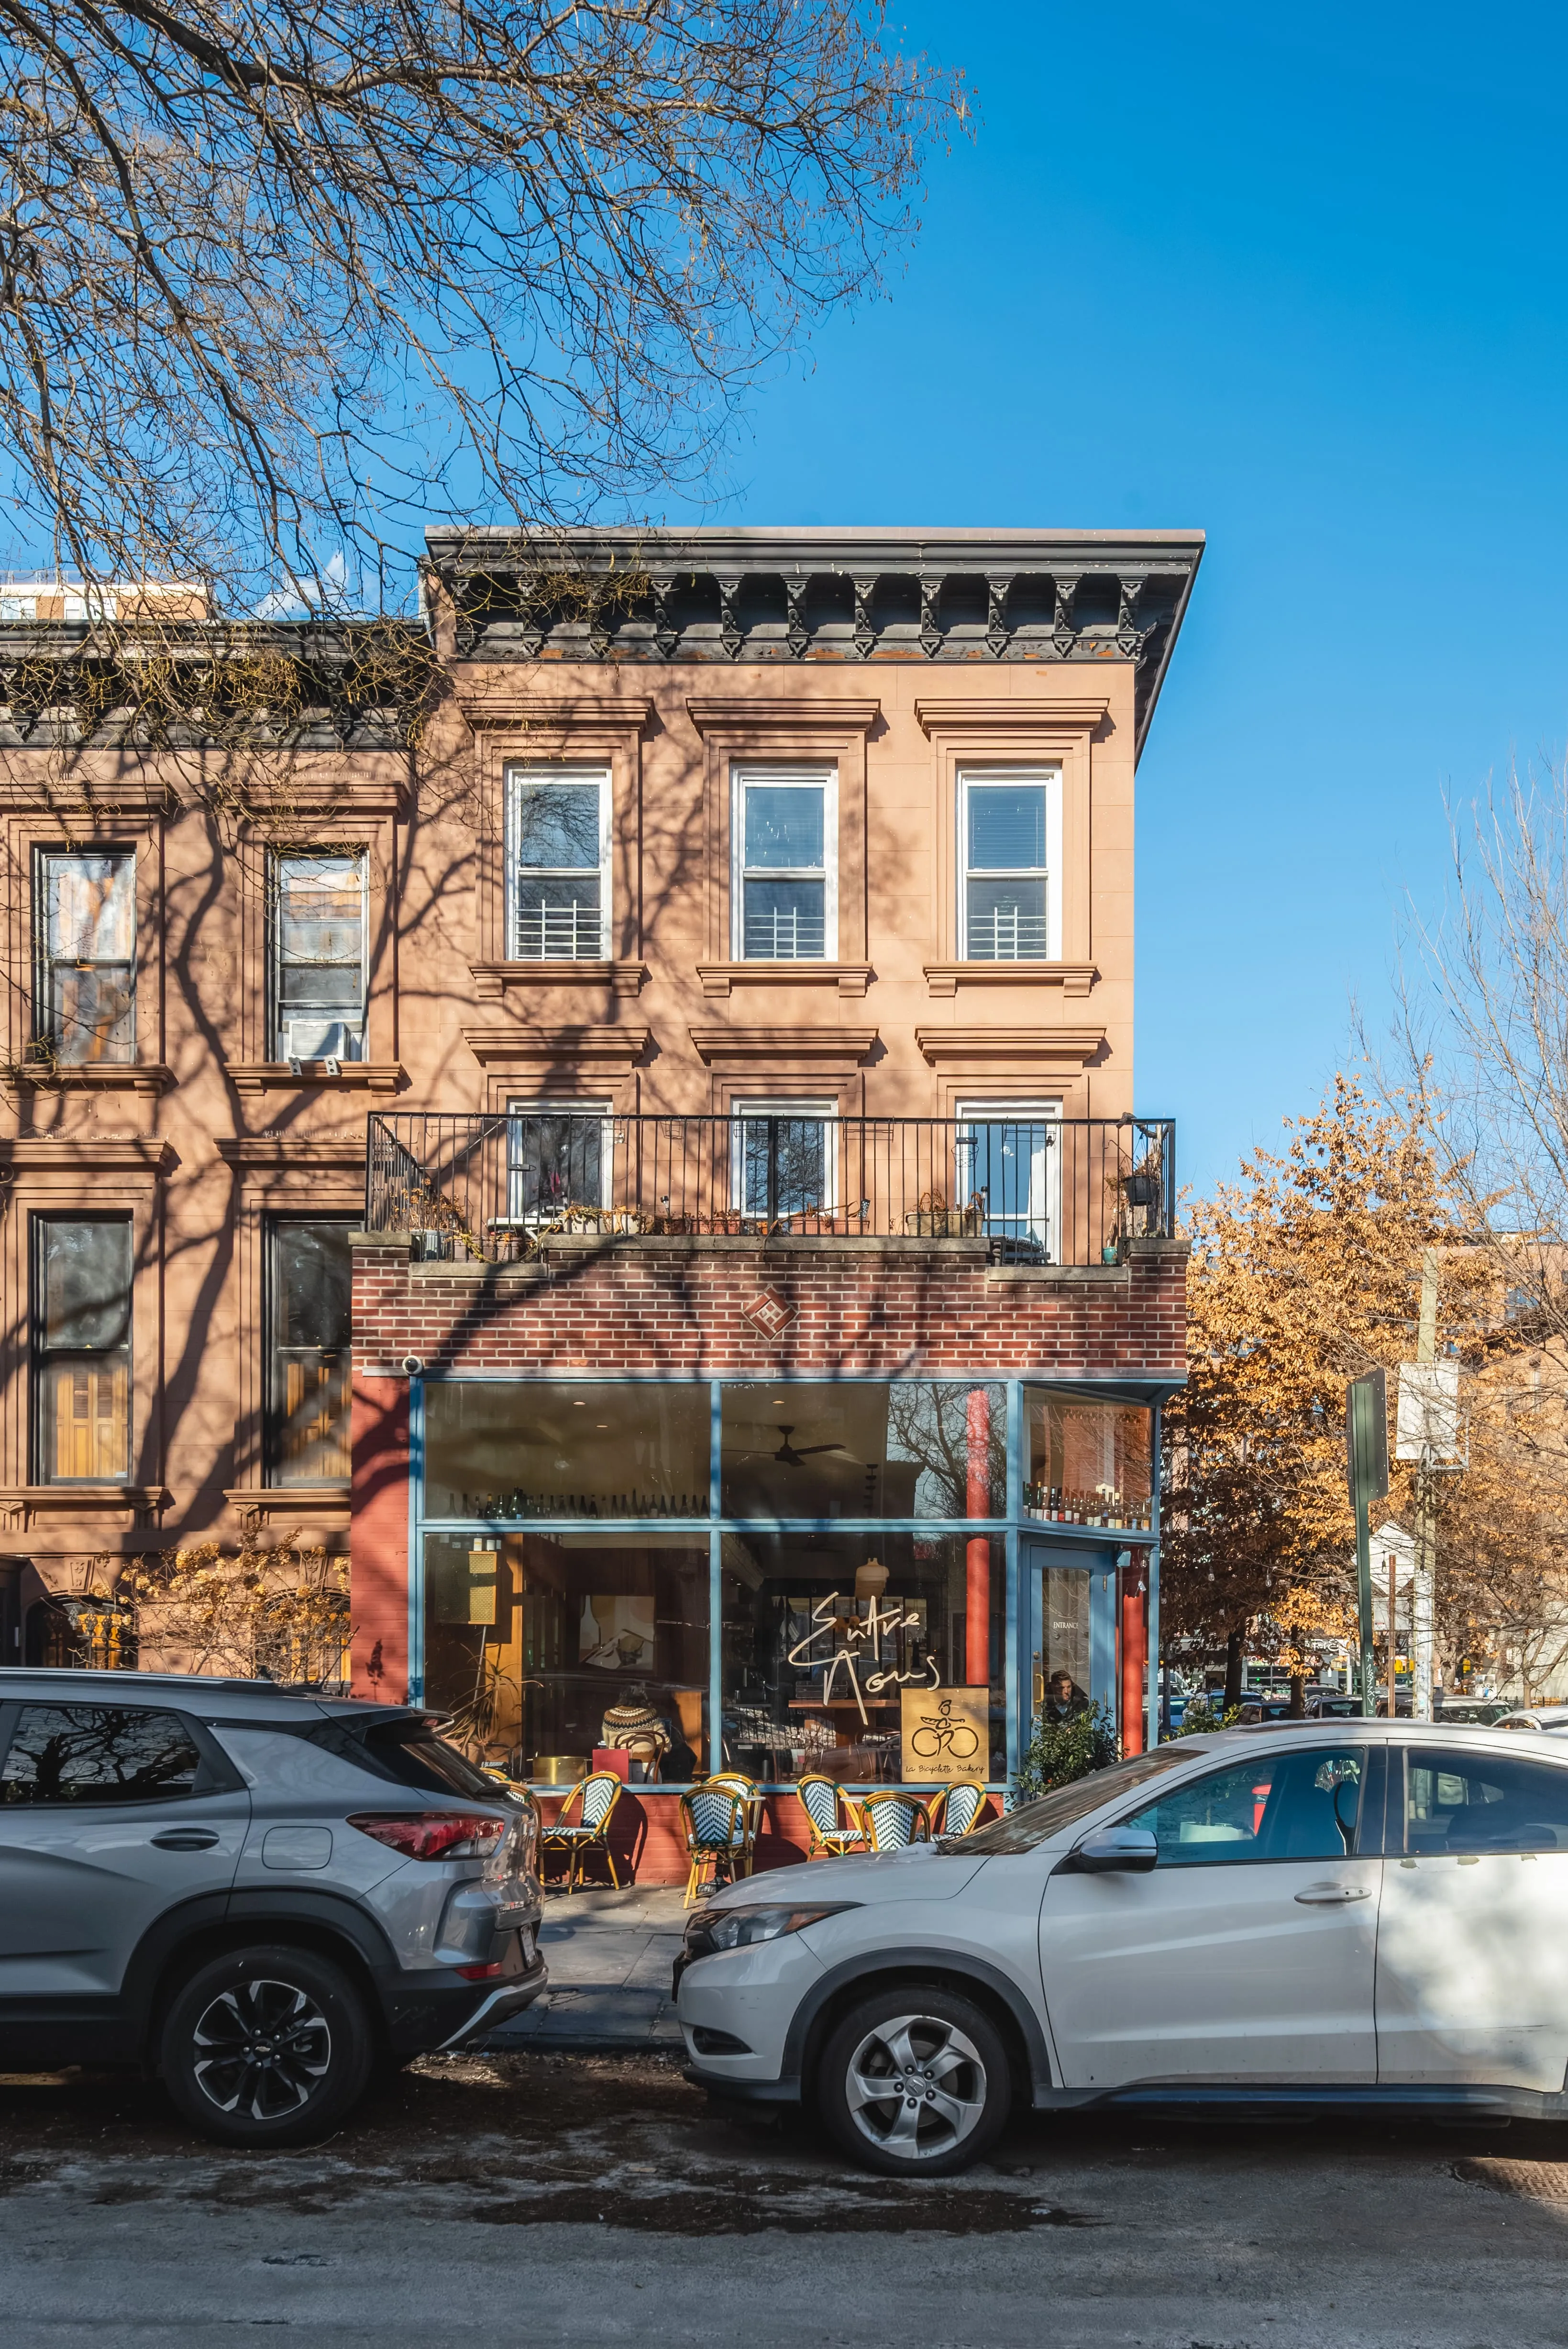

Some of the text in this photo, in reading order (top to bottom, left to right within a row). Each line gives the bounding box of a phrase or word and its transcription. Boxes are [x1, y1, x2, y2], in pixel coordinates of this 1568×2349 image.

[788, 1591, 920, 1666] Entre
[918, 1764, 954, 1775] Bicyclette
[957, 1764, 985, 1774] Bakery
